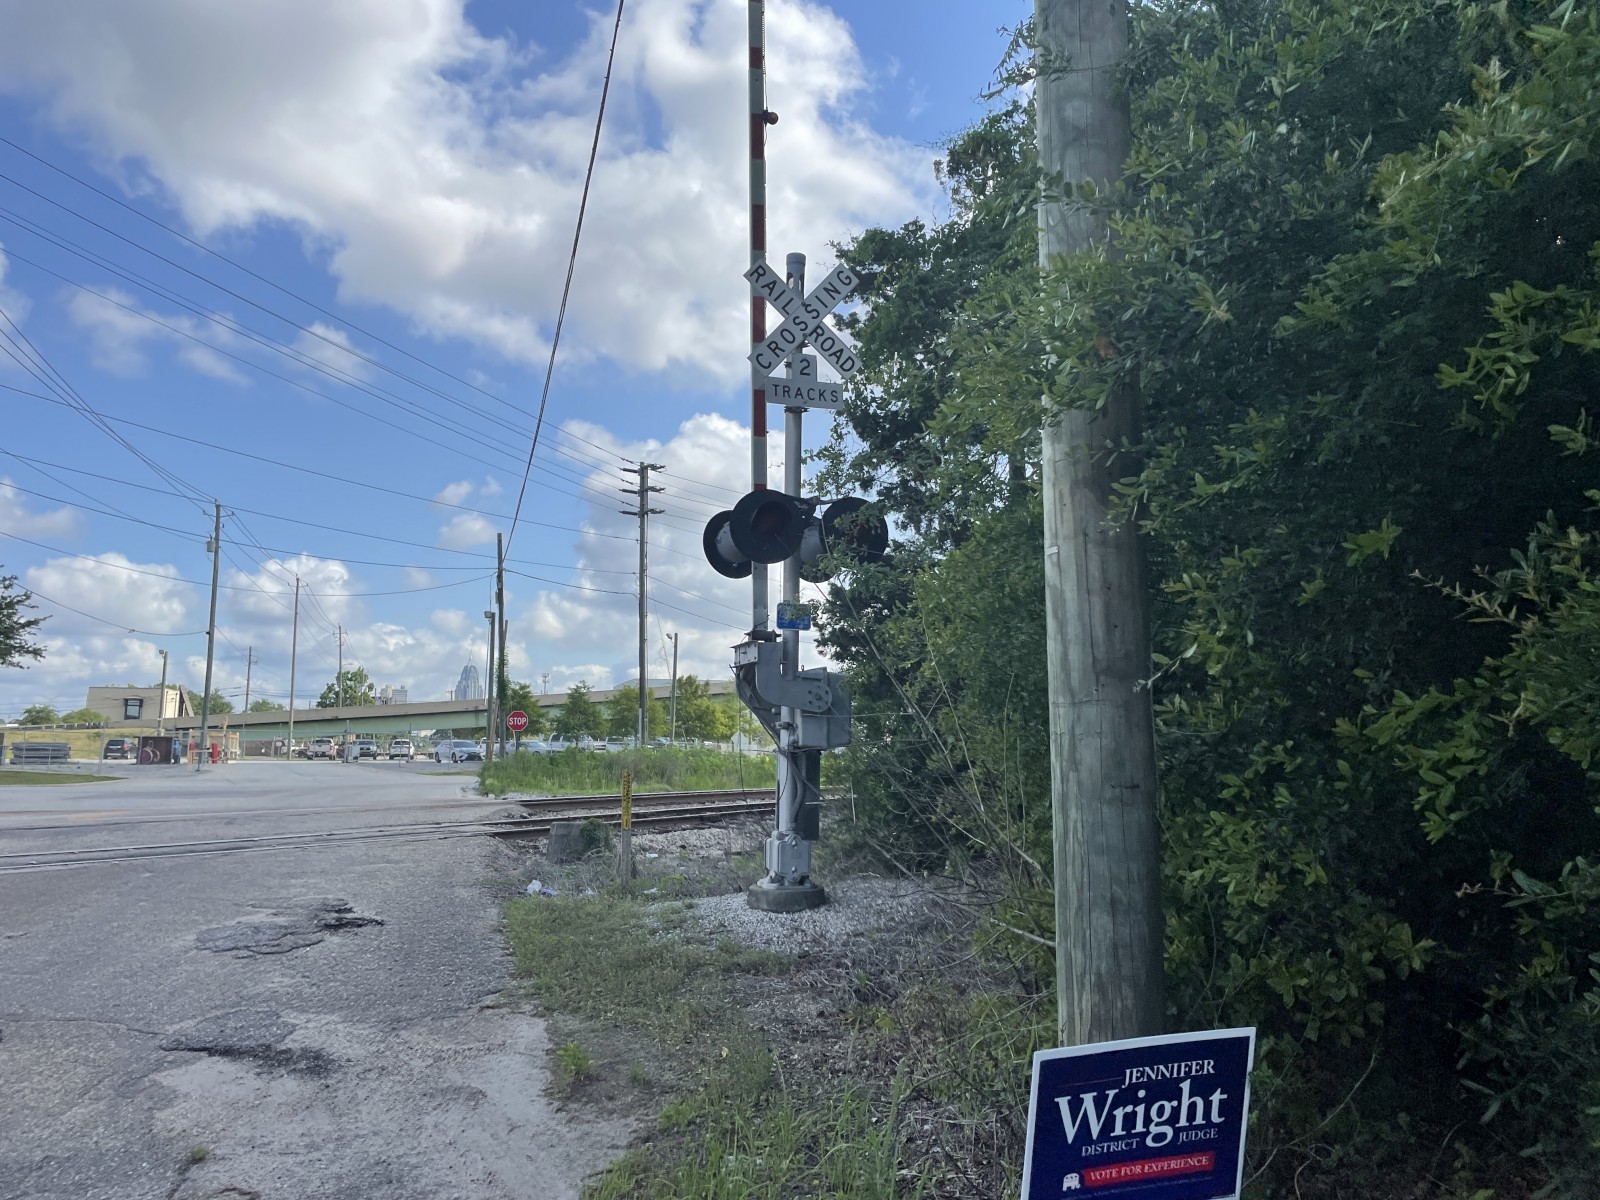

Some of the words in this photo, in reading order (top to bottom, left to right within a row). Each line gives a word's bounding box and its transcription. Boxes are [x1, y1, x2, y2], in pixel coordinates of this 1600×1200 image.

[750, 264, 794, 315] RAIL
[808, 324, 855, 373] ROAD
[756, 270, 852, 370] CROSSING
[799, 358, 811, 376] 2
[772, 384, 838, 403] TRACKS
[509, 717, 527, 726] STOP
[1121, 1059, 1215, 1089] JENNIFER
[1054, 1078, 1228, 1148] Wright
[1081, 1138, 1140, 1157] DISTRICT
[1177, 1127, 1218, 1145] JUDGE
[1090, 1168, 1119, 1181] VOTE
[1121, 1165, 1142, 1176] FOR
[1143, 1156, 1209, 1174] EXPERIENCE
